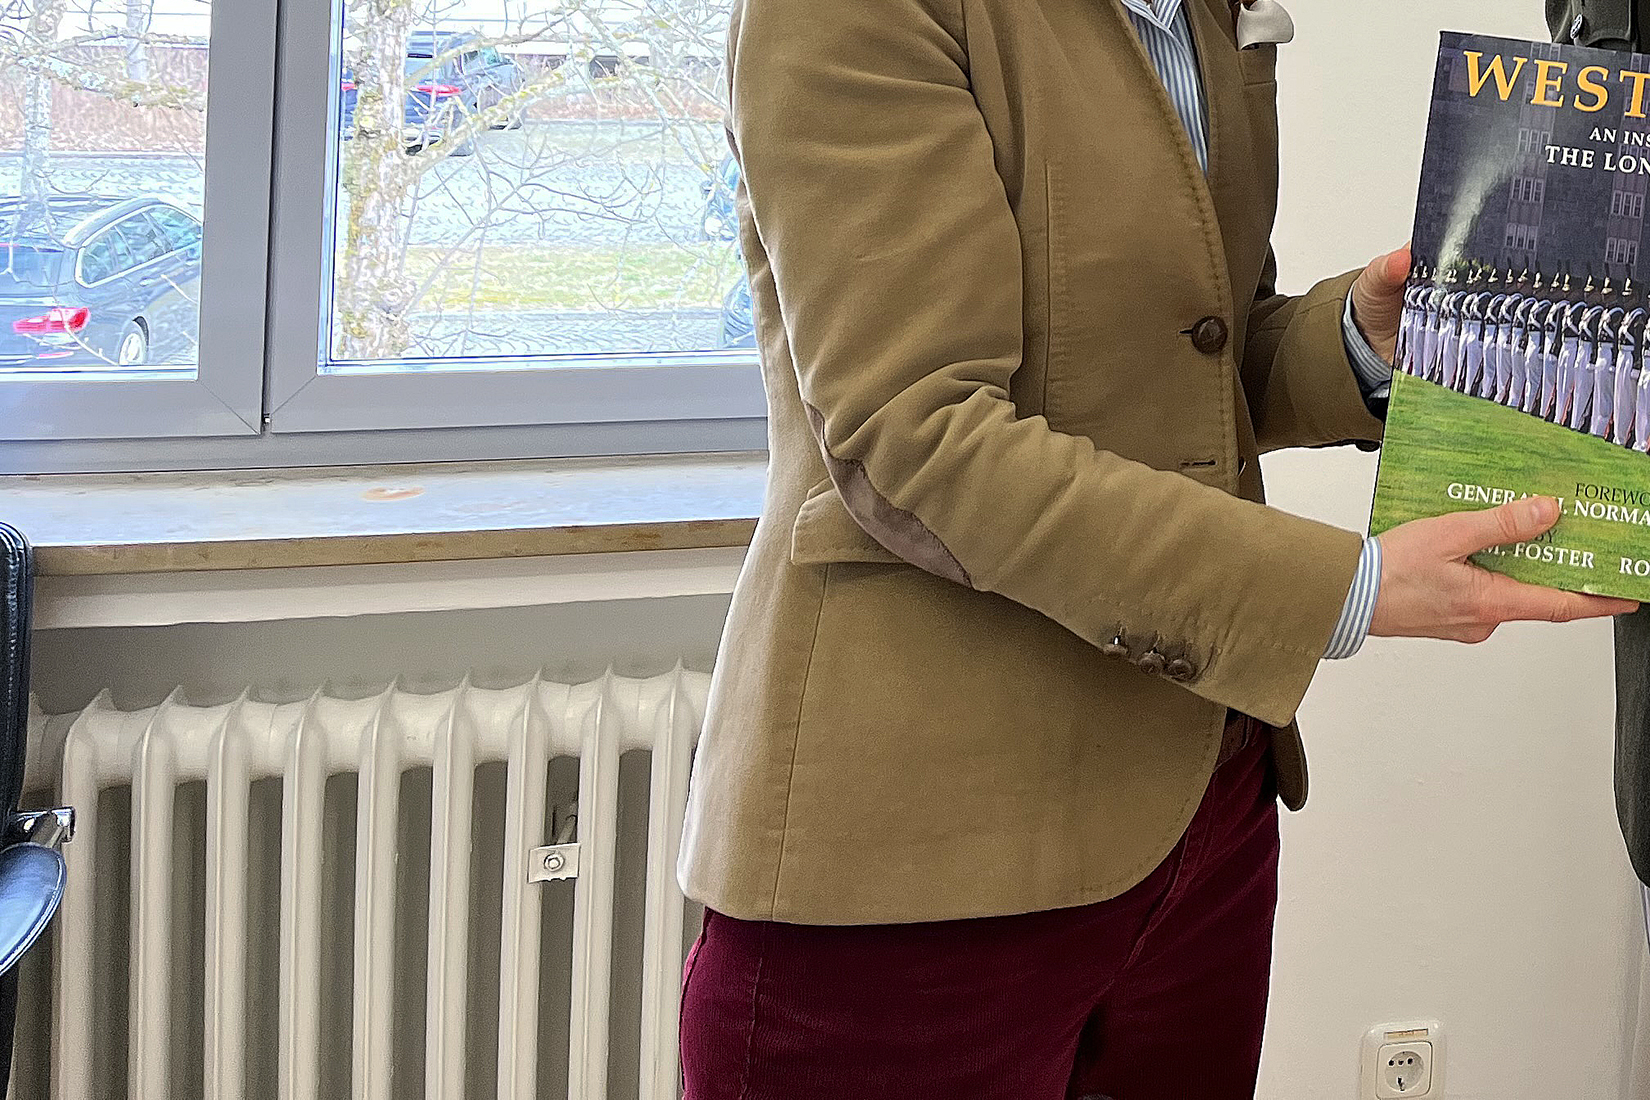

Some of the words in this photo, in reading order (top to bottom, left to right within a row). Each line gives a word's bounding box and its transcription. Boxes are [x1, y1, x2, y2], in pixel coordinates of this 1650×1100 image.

[1589, 127, 1617, 143] AN
[1545, 145, 1595, 169] THE
[1447, 482, 1539, 505] GENER
[1513, 542, 1595, 569] FOSTER
